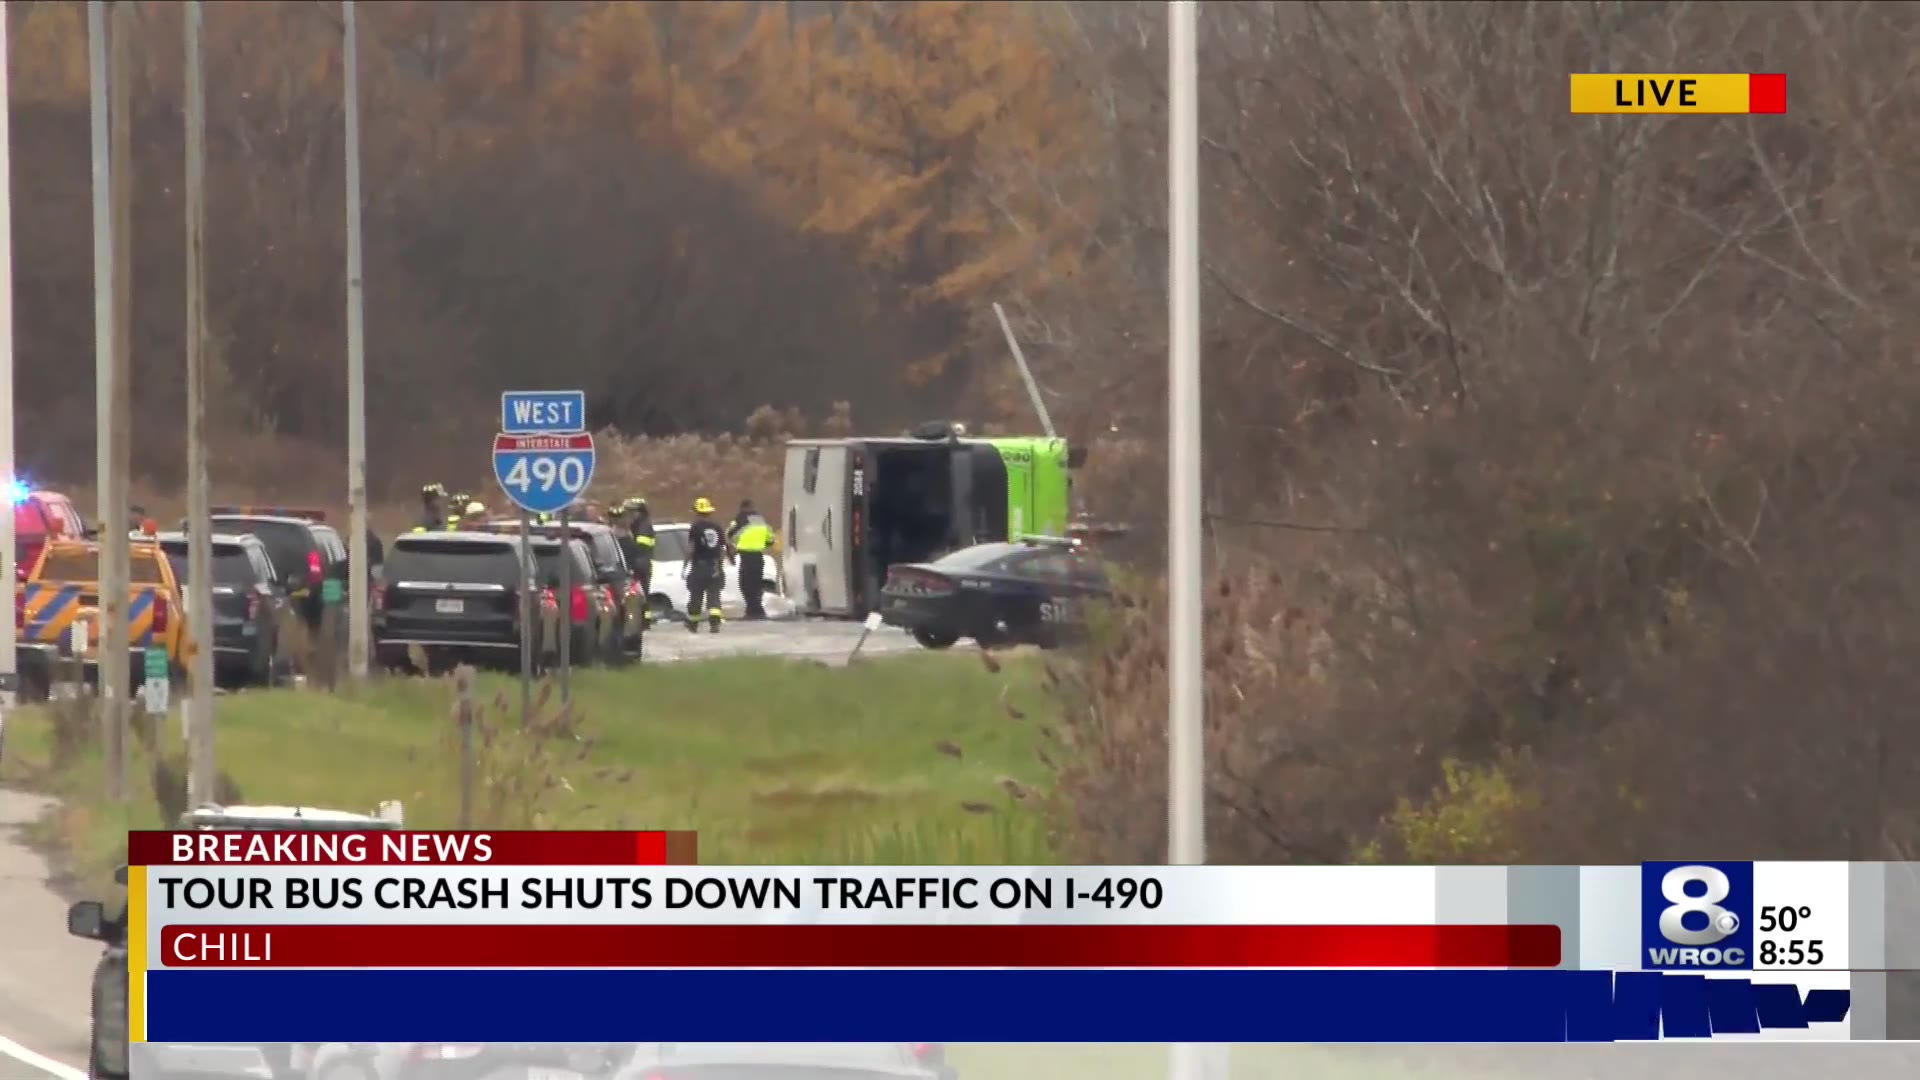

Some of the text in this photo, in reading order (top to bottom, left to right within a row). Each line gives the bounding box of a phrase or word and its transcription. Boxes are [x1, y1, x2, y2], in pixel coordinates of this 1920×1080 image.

[513, 400, 573, 424] WEST
[515, 438, 570, 448] INTERSTATE
[505, 456, 585, 493] 490
